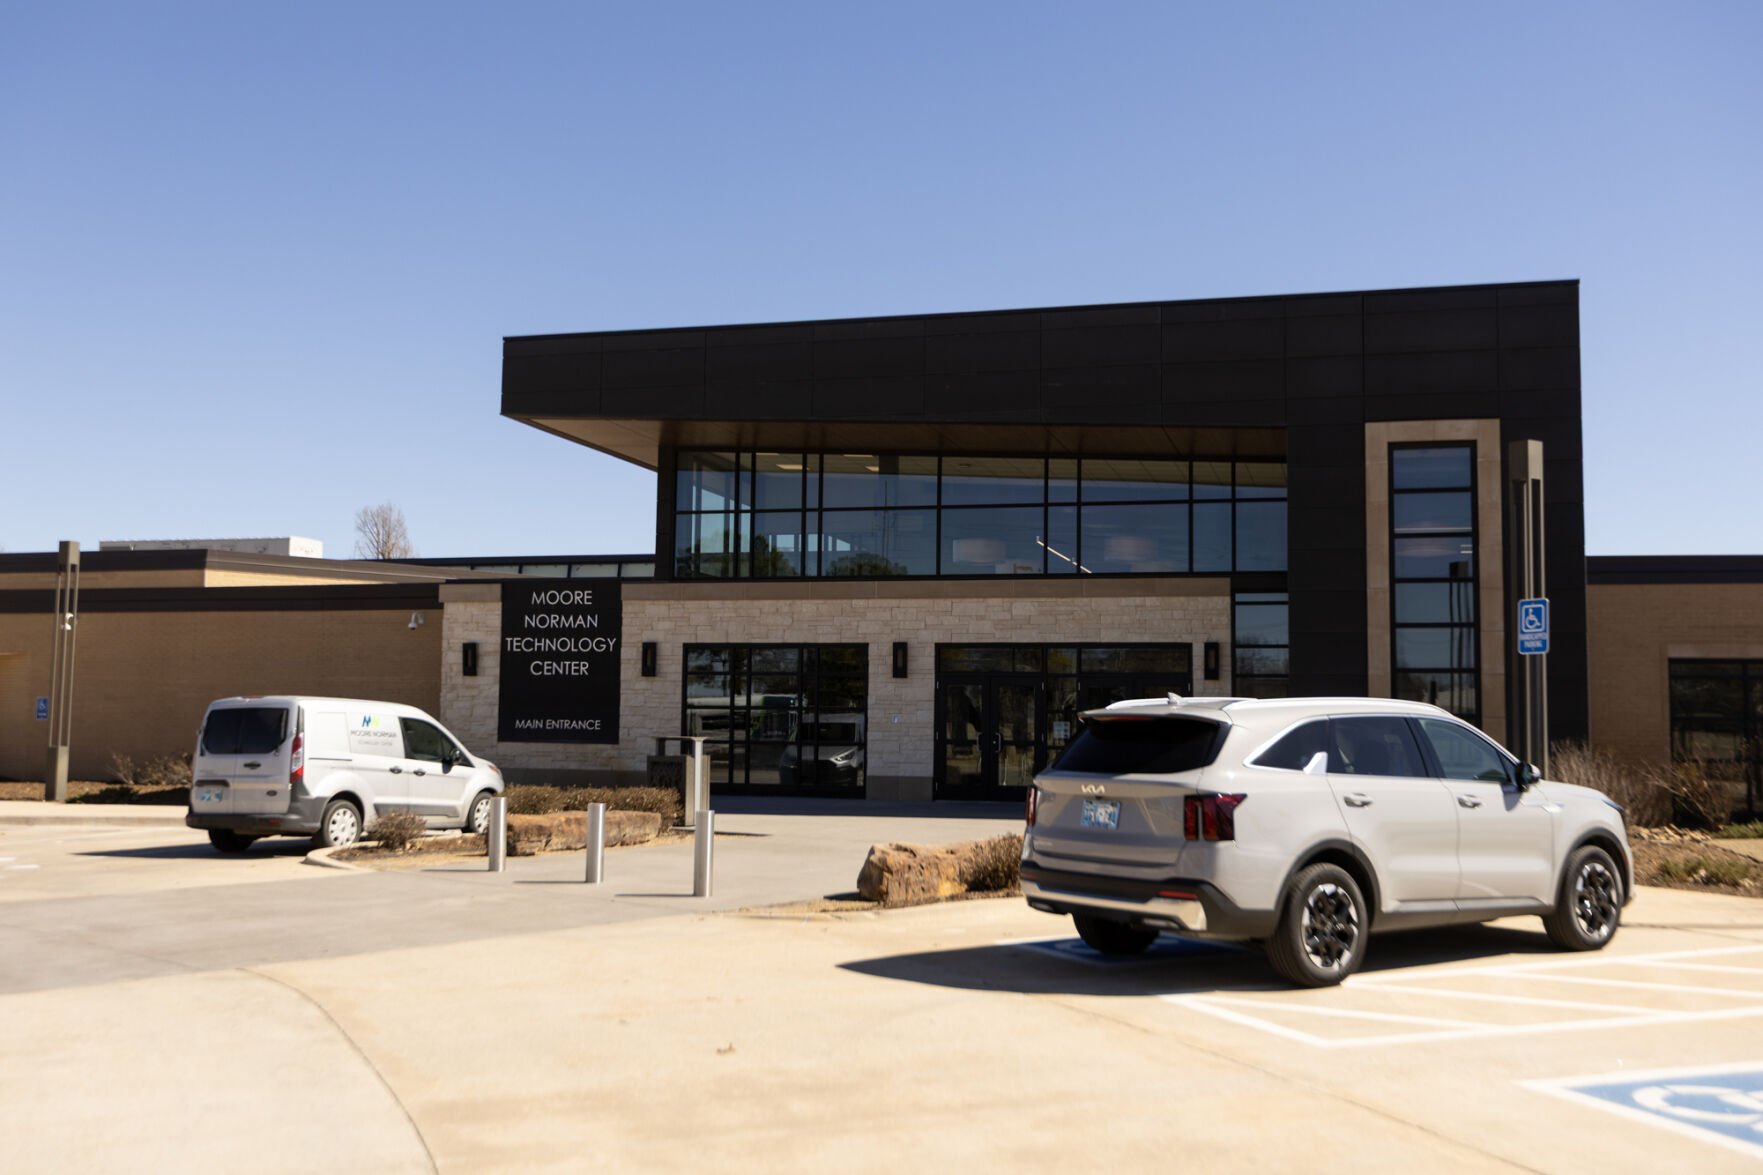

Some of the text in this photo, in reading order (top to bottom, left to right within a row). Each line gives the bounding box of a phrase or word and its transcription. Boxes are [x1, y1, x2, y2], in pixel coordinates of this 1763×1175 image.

[531, 590, 593, 605] MOORE
[524, 613, 598, 629] NORMAN
[505, 637, 617, 652] TECHNOLOGY
[530, 660, 589, 675] CENTER
[515, 719, 601, 730] MAIN ENTRANCE
